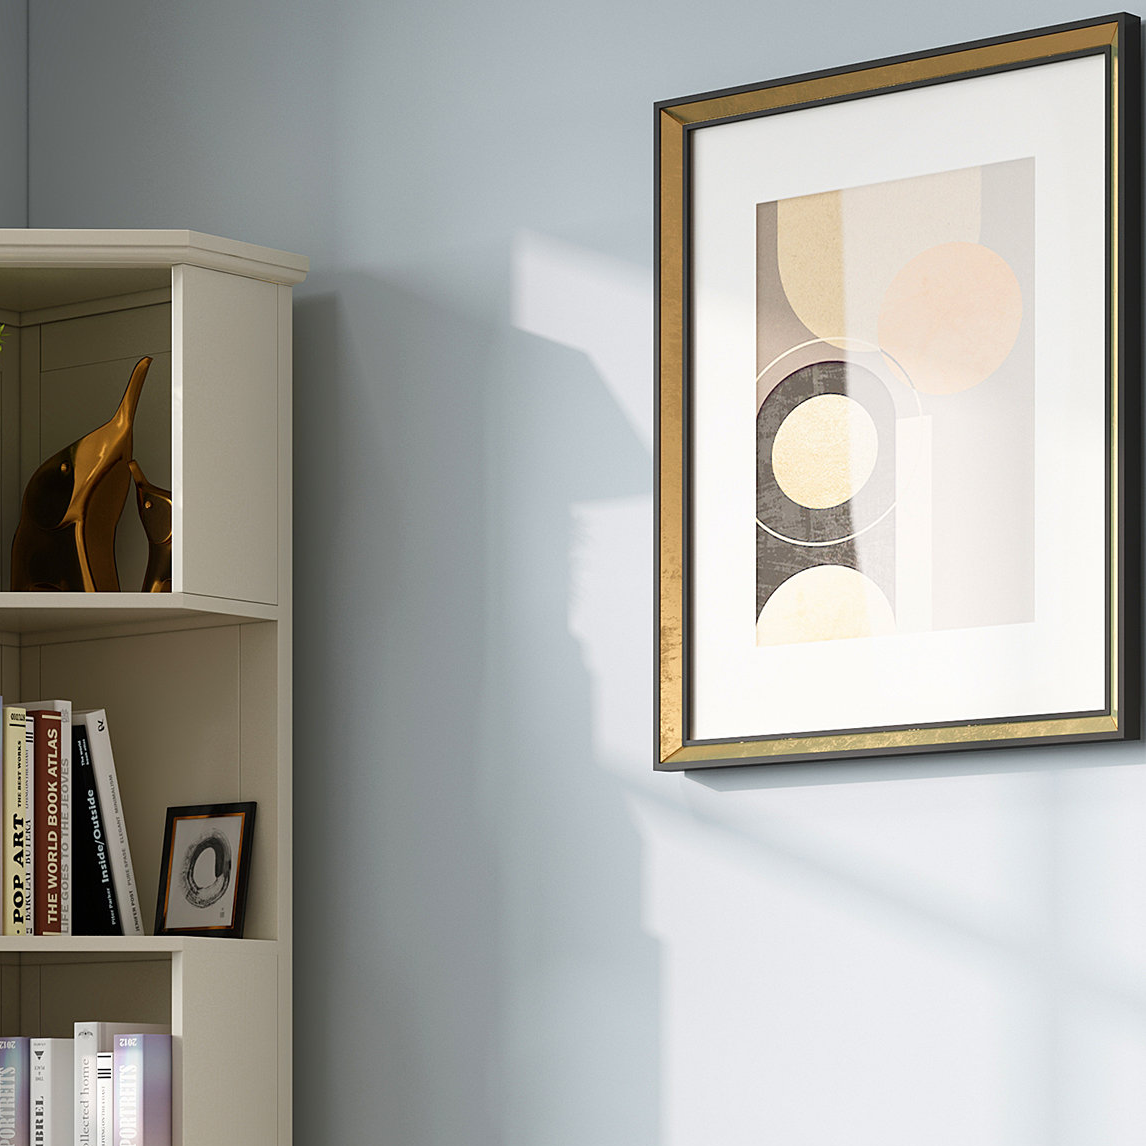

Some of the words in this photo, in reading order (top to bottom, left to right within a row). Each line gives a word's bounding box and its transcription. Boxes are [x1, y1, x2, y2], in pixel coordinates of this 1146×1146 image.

[47, 728, 58, 778] ATLAS
[47, 781, 58, 826] BOOK
[13, 813, 24, 868] ART
[61, 812, 69, 837] THE
[87, 789, 109, 883] Inside/Outside
[47, 831, 58, 889] WORLD
[61, 842, 69, 860] TO
[13, 874, 24, 924] POP
[61, 864, 69, 900] GOES
[106, 888, 114, 909] Parker
[48, 893, 58, 924] THE
[61, 905, 69, 933] LIFE
[0, 1040, 16, 1050] 2012
[119, 1038, 137, 1047] 2012
[80, 1059, 89, 1095] home
